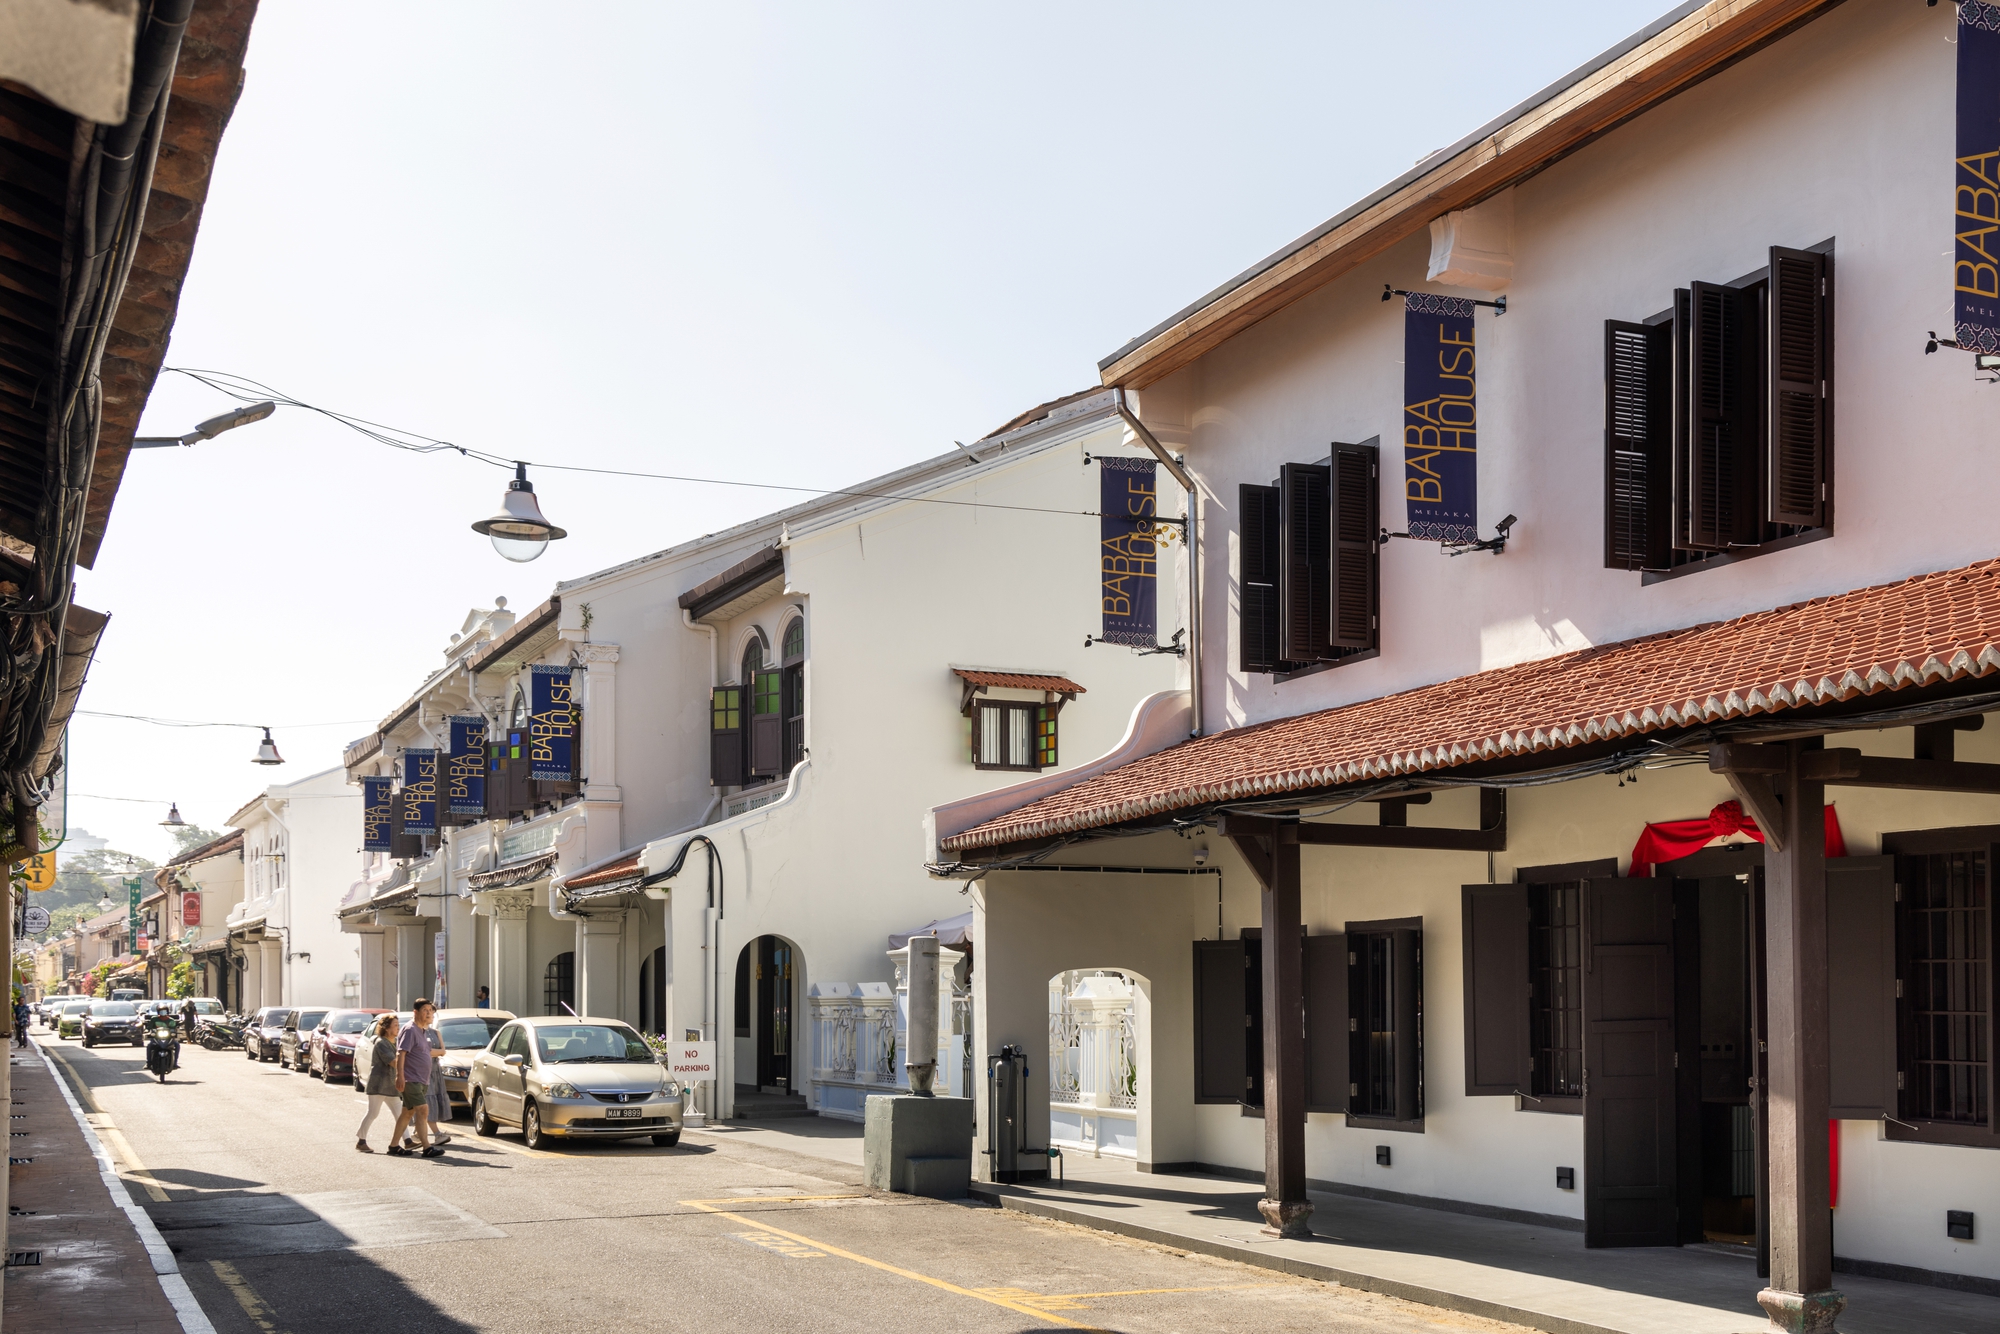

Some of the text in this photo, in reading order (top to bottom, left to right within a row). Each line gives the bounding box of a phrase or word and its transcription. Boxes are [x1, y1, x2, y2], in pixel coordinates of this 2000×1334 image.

[1955, 150, 1999, 299] BABA
[1439, 323, 1478, 453] HOUSE
[1404, 398, 1442, 503] BABA
[1415, 508, 1470, 518] MELAKA
[1101, 534, 1130, 617] BABA
[1108, 620, 1151, 629] MELAKA
[551, 677, 573, 738] HOUSE
[466, 726, 485, 778] HOUSE
[531, 710, 553, 761] BABA
[419, 757, 436, 803] HOUSE
[450, 754, 468, 798] BABA
[364, 805, 379, 840] BABA
[377, 784, 393, 824] HOUSE
[404, 782, 421, 821] BABA
[674, 1064, 710, 1073] PARKING
[685, 1050, 698, 1059] NO
